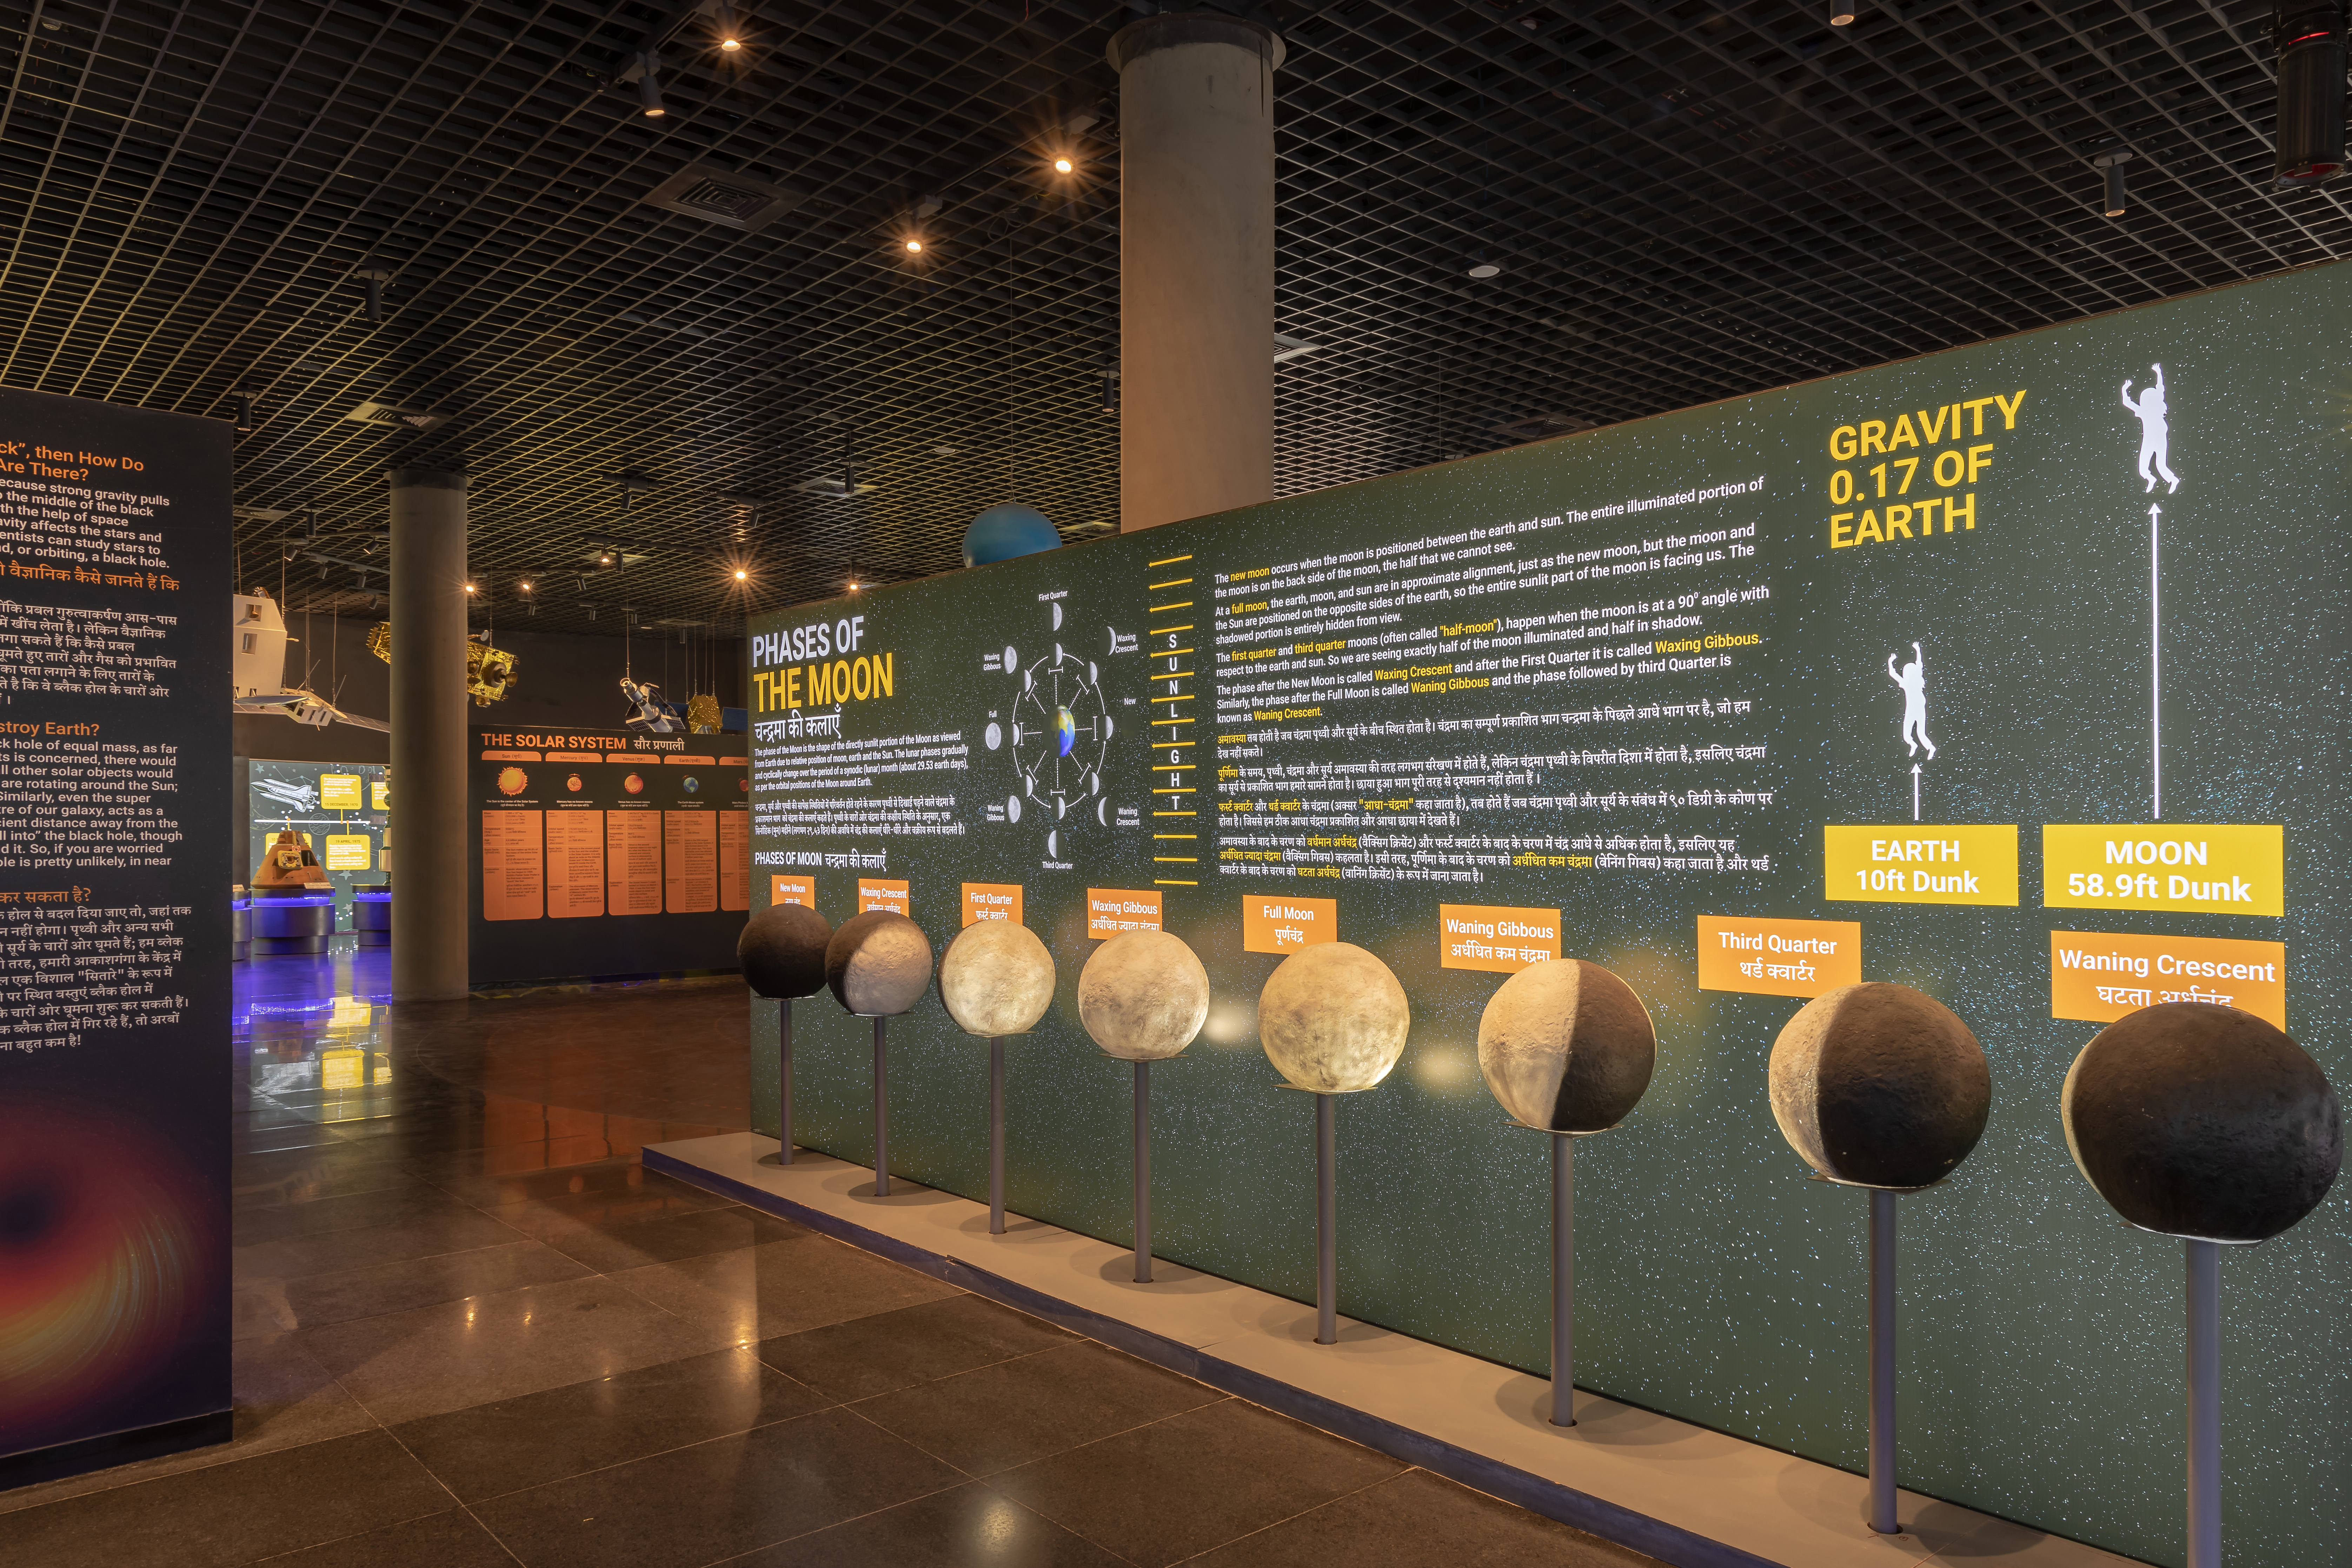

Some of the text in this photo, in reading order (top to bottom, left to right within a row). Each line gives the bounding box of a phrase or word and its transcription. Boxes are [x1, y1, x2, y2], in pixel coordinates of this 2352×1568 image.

[1830, 390, 2026, 461] GRAVITY
[35, 446, 73, 462] then
[79, 451, 117, 467] How
[122, 457, 144, 471] Do
[0, 459, 88, 481] Are There?
[1830, 443, 1993, 505] 0.17 OF
[49, 484, 91, 499] strong
[95, 491, 137, 504] gravity
[140, 495, 170, 506] pulls
[1831, 493, 1975, 549] EARTH
[8, 560, 180, 591] वैज्ञानिक कैसे जानते हैं कि
[1039, 591, 1068, 601] First Quarter
[1216, 613, 1402, 645] shadowed portion is entirely hidden from view.
[753, 616, 864, 667] PHASES OF
[1115, 634, 1136, 645] Waxing
[1115, 644, 1138, 653] Crescent
[1655, 633, 1762, 653] Waxing Gibbous.
[753, 652, 892, 712] THE MOON
[754, 703, 842, 743] चन्द्रमा की कलाएँ
[989, 710, 997, 718] Full
[1217, 706, 1323, 723] known as Waning Crescent.
[46, 722, 99, 736] Earth?
[481, 733, 685, 751] THE SOLAR SYSTEM सौर प्रणाली
[754, 748, 763, 757] The
[763, 747, 776, 758] phase
[776, 746, 782, 755] of
[789, 745, 802, 753] Moon
[803, 744, 807, 752] is
[808, 743, 816, 752] the
[816, 743, 830, 753] shape
[831, 741, 836, 750] of
[836, 741, 845, 750] the
[845, 739, 864, 750] directly
[864, 738, 879, 748] sunlit
[879, 737, 898, 749] portion
[899, 735, 905, 745] of
[905, 735, 915, 744] the
[915, 734, 931, 744] Moon
[940, 730, 961, 742] viewed
[1217, 745, 1263, 760] देख नहीं सकते।
[26, 779, 77, 791] rotating
[81, 780, 125, 790] around
[128, 780, 148, 790] the
[151, 781, 178, 792] Sun;
[0, 791, 54, 804] Similarly,
[92, 792, 112, 802] the
[116, 795, 151, 805] super
[987, 804, 1004, 813] Waning
[1118, 808, 1137, 817] Waning
[755, 848, 886, 872] PHASES OF MOON चन्द्रमा की कलाएँ
[1872, 840, 1960, 862] EARTH
[2106, 841, 2207, 865] MOON
[1055, 862, 1073, 870] Quarter
[780, 883, 805, 893] New Moon
[1856, 869, 1980, 893] 10ft Dunk
[2068, 873, 2252, 902] 58.9ft Dunk
[861, 887, 907, 899] Waxing Crescent
[971, 892, 1013, 905] First Quarter
[975, 908, 1008, 921] फर्स्ट क्वार्टर
[1092, 900, 1158, 915] Waxing Gibbous
[1264, 905, 1314, 921] Full Moon
[1274, 925, 1304, 946] पूर्णचंद्र
[1446, 919, 1554, 939] Waning Gibbous
[1718, 932, 1837, 955] Third Quarter
[1494, 947, 1517, 961] कम
[1518, 945, 1551, 964] चंद्रमा
[1740, 957, 1816, 982] थर्ड क्वार्टर
[2059, 949, 2276, 982] Waning Crescent
[2095, 986, 2152, 1007] घटता
